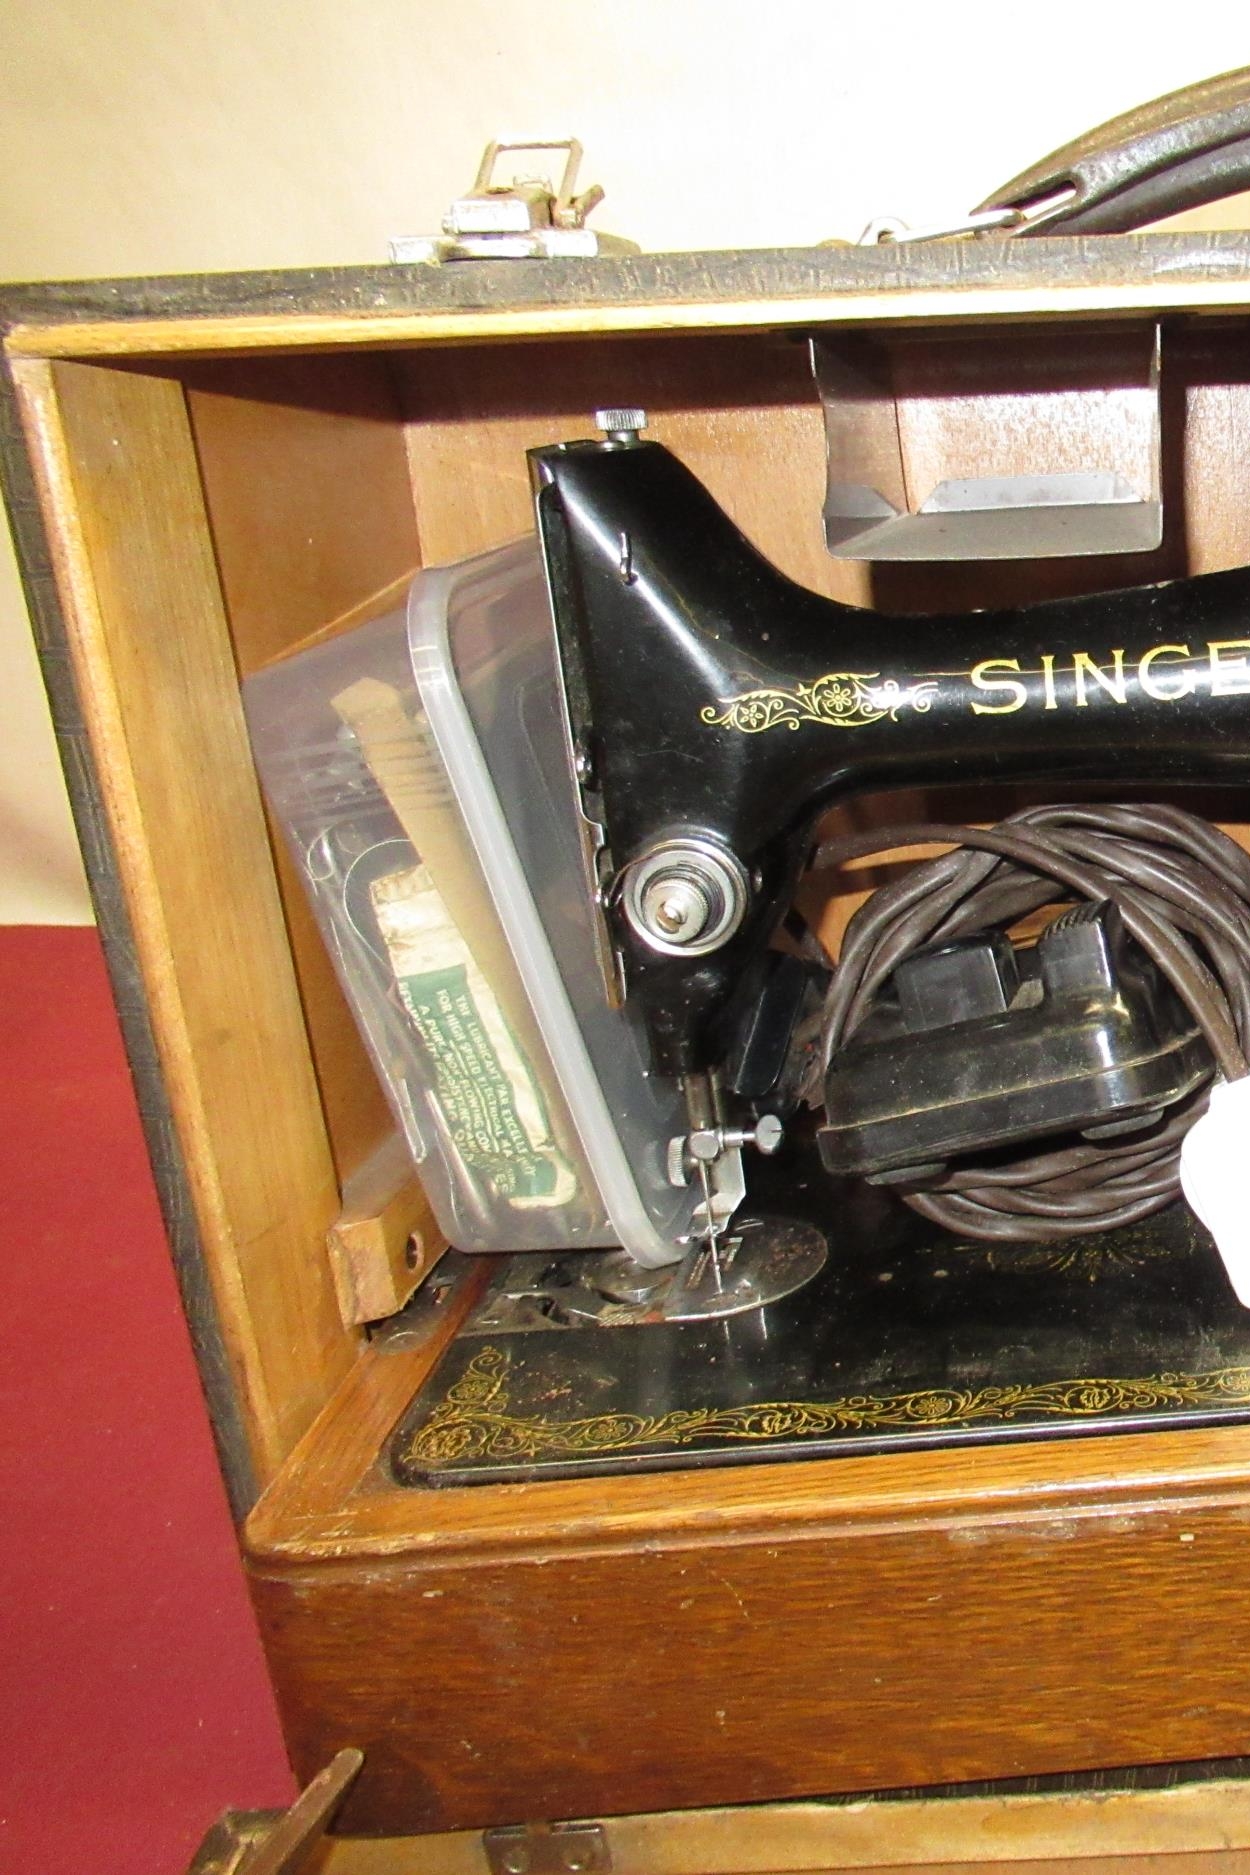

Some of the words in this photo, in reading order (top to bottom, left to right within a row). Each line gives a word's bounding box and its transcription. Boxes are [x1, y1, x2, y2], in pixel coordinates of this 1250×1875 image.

[435, 990, 452, 1013] FOR
[447, 1014, 464, 1041] HIGH
[459, 1041, 482, 1076] SPEED
[467, 1022, 501, 1081] LUBRICANT
